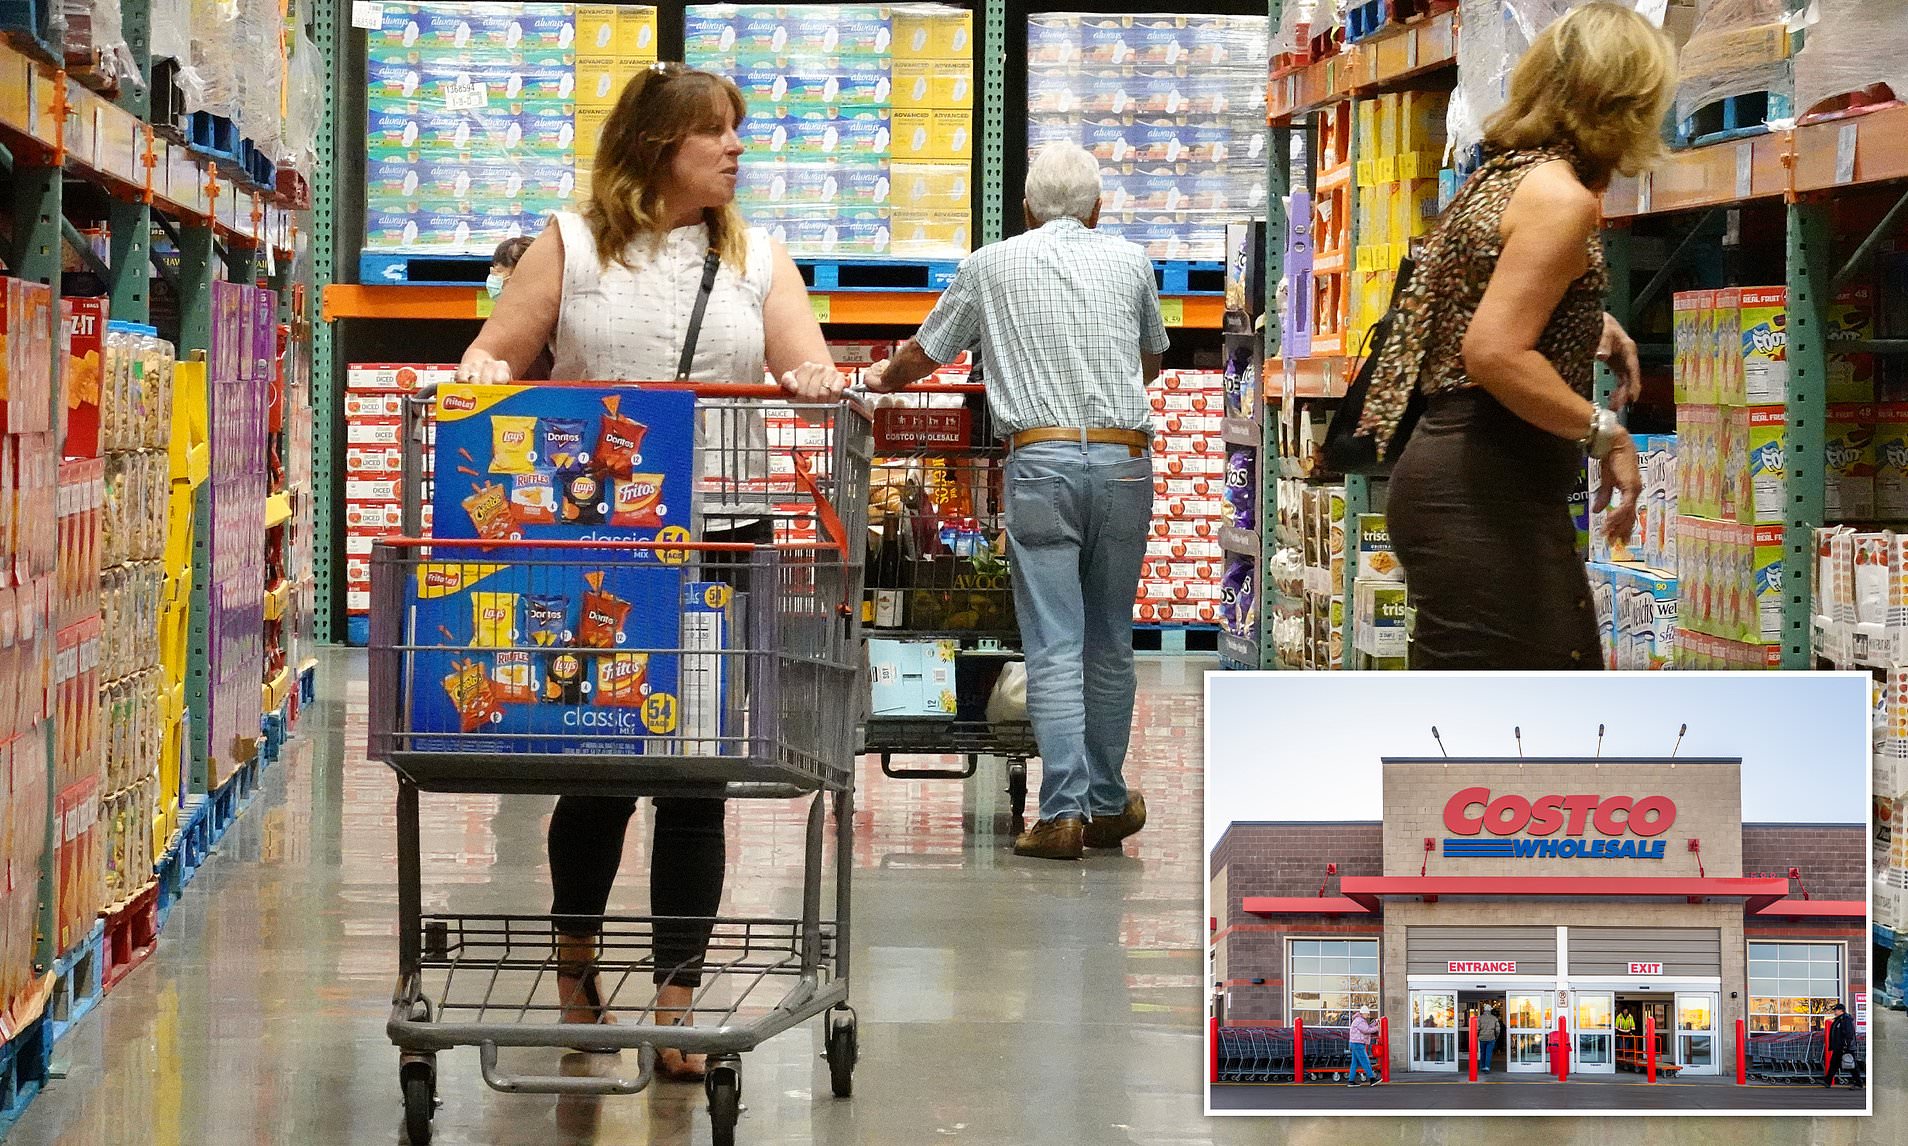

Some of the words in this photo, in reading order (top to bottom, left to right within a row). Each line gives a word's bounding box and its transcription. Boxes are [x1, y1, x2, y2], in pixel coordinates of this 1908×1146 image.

[431, 15, 460, 28] always
[534, 15, 564, 28] always
[695, 20, 725, 32] always
[747, 20, 777, 32] always
[799, 20, 829, 32] always
[850, 20, 880, 32] always
[1093, 30, 1122, 42] always
[1147, 30, 1177, 42] always
[747, 70, 777, 83] always
[850, 70, 880, 83] always
[378, 116, 408, 128] always
[534, 116, 564, 128] always
[747, 120, 776, 133] always
[798, 120, 828, 133] always
[850, 120, 879, 133] always
[1093, 127, 1122, 139] always
[1147, 127, 1177, 139] always
[378, 166, 408, 178] always
[430, 166, 460, 178] always
[534, 166, 564, 178] always
[746, 171, 776, 183] always
[798, 171, 828, 183] always
[850, 171, 879, 183] always
[1147, 178, 1176, 190] always
[378, 216, 408, 228] always
[430, 216, 459, 228] always
[482, 216, 511, 228] always
[1147, 226, 1176, 238] always
[1761, 294, 1780, 302] FRUIT
[547, 432, 580, 442] Doritos
[605, 433, 634, 449] Doritos
[885, 433, 914, 441] COSTCO
[516, 474, 549, 486] RUFFLES
[620, 481, 656, 503] Fritos
[580, 530, 650, 550] classic
[633, 551, 649, 559] MIX
[530, 609, 562, 619] Dortos
[588, 610, 616, 625] Dorito
[648, 700, 672, 719] 54
[926, 699, 937, 708] 12
[563, 706, 636, 727] classic
[1443, 786, 1677, 837] COSTCO
[1512, 838, 1667, 859] WHOLESALE
[1449, 961, 1515, 972] ENTRANCE
[1630, 963, 1661, 974] EXIT
